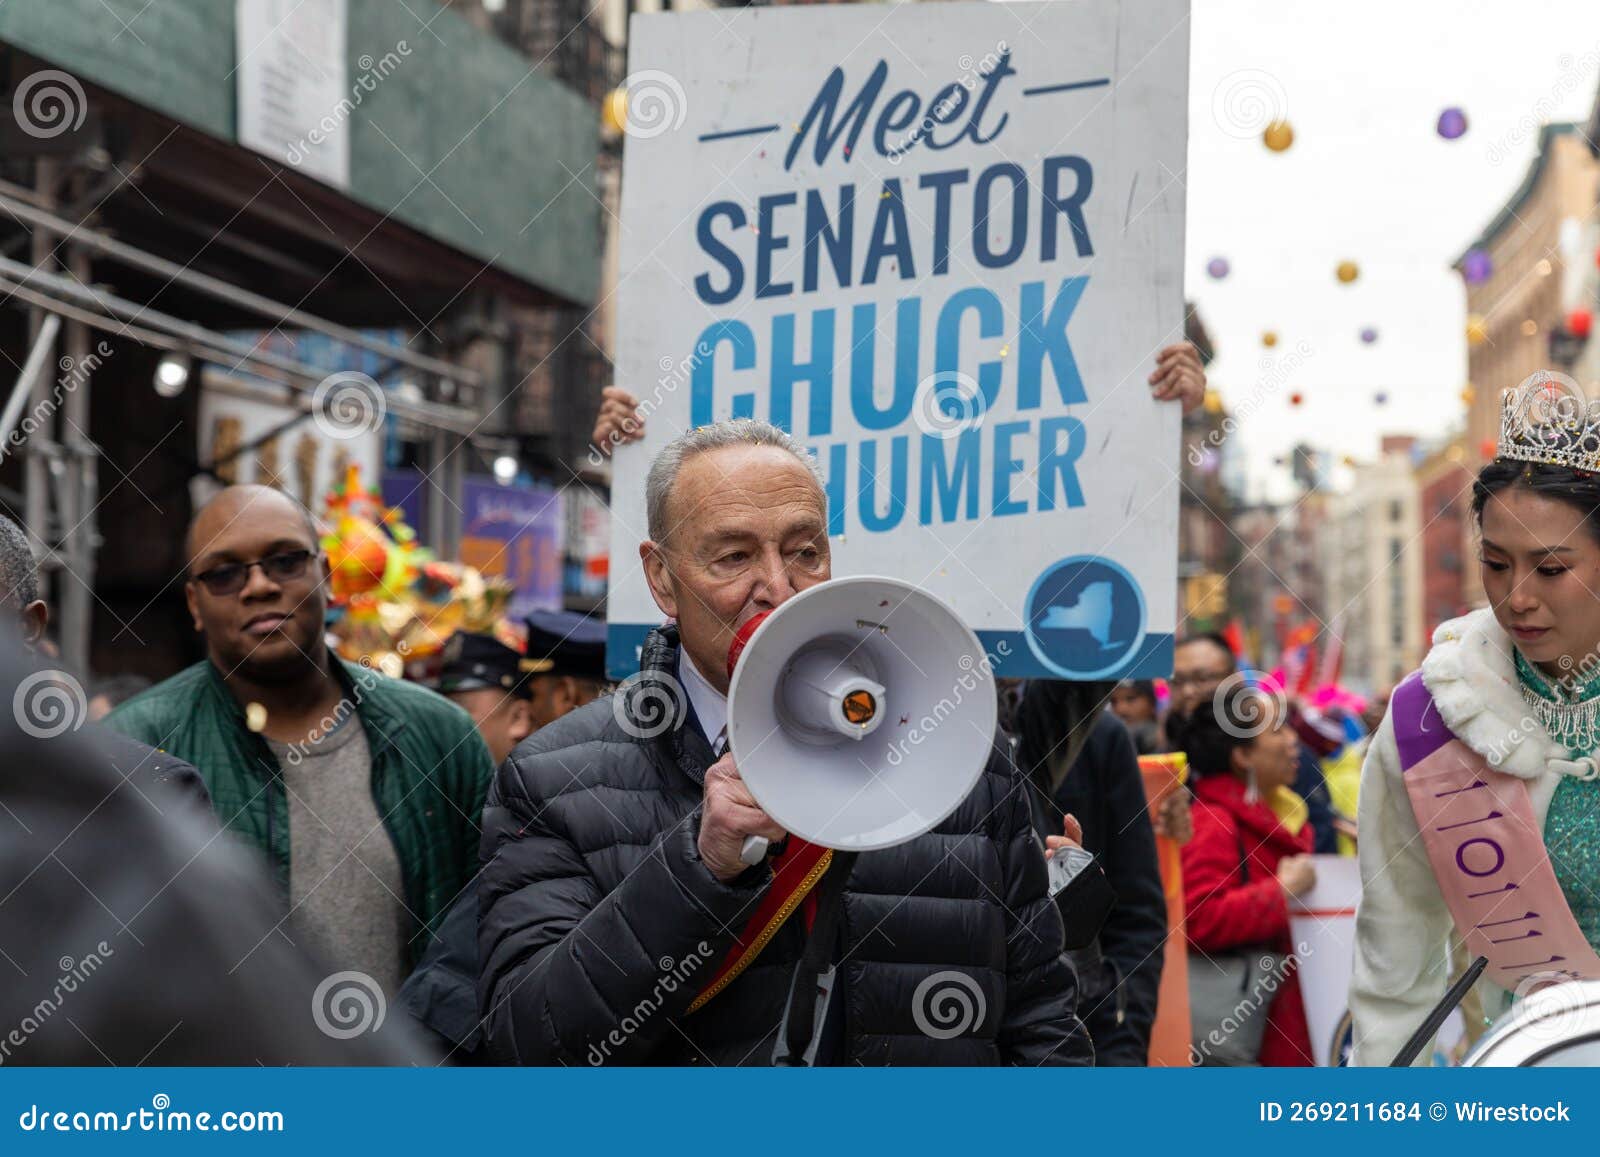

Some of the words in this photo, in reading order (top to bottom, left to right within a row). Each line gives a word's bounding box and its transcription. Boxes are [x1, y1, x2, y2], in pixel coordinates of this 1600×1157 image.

[784, 48, 1016, 171] Meet
[695, 156, 1094, 305] SENATOR
[690, 274, 1090, 438] CHUCK
[806, 416, 1087, 537] HUMER
